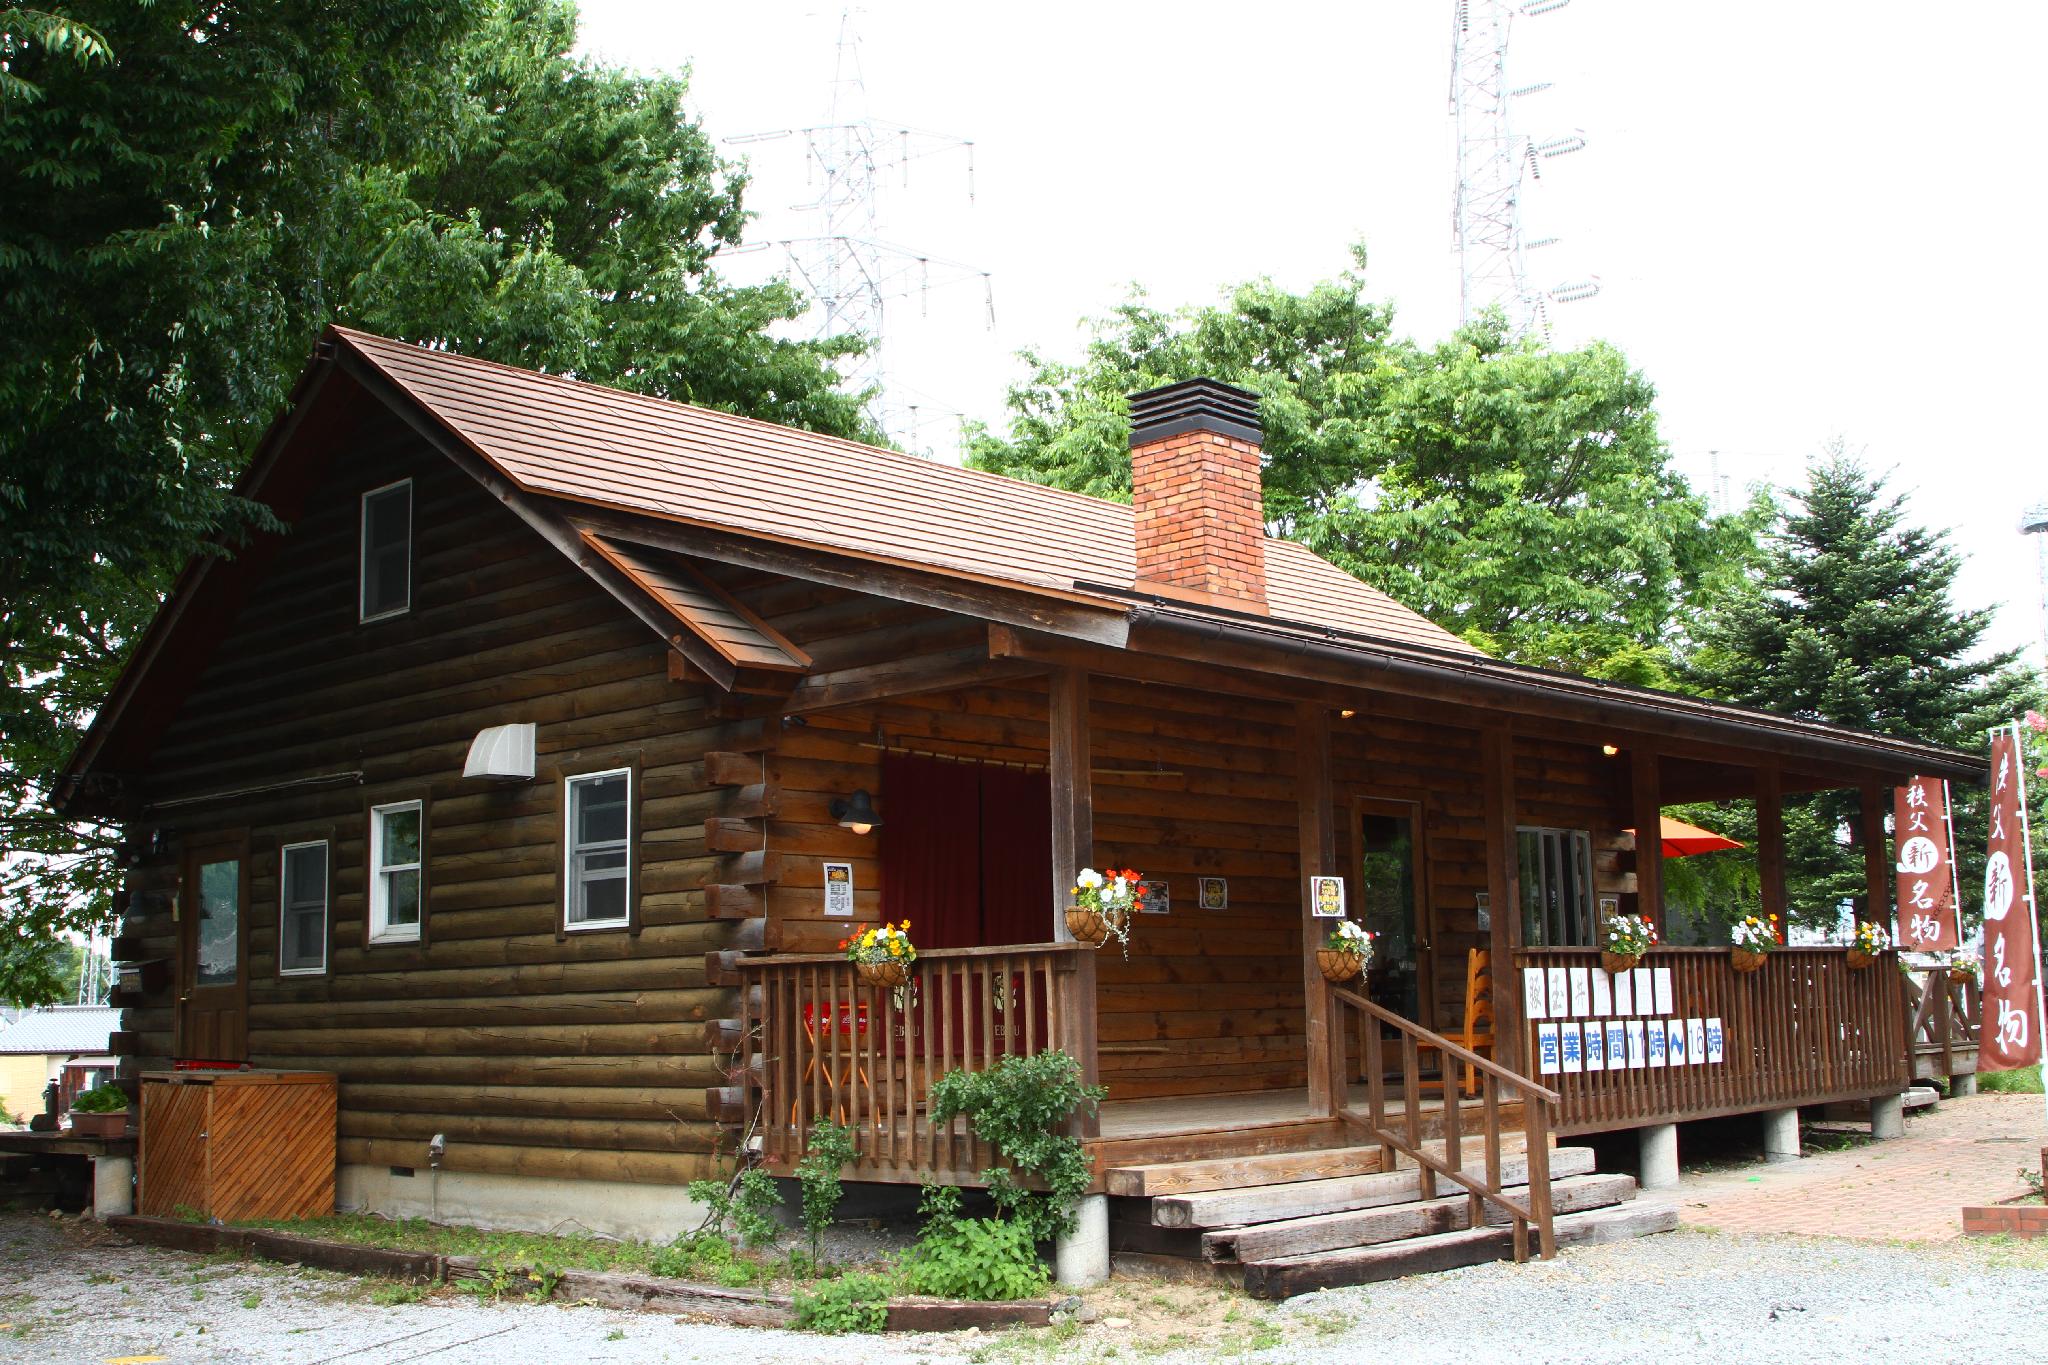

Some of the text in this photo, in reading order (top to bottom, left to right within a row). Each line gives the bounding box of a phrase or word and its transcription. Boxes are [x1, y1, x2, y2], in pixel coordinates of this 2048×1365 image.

[1906, 784, 1941, 944] 秩父新名物
